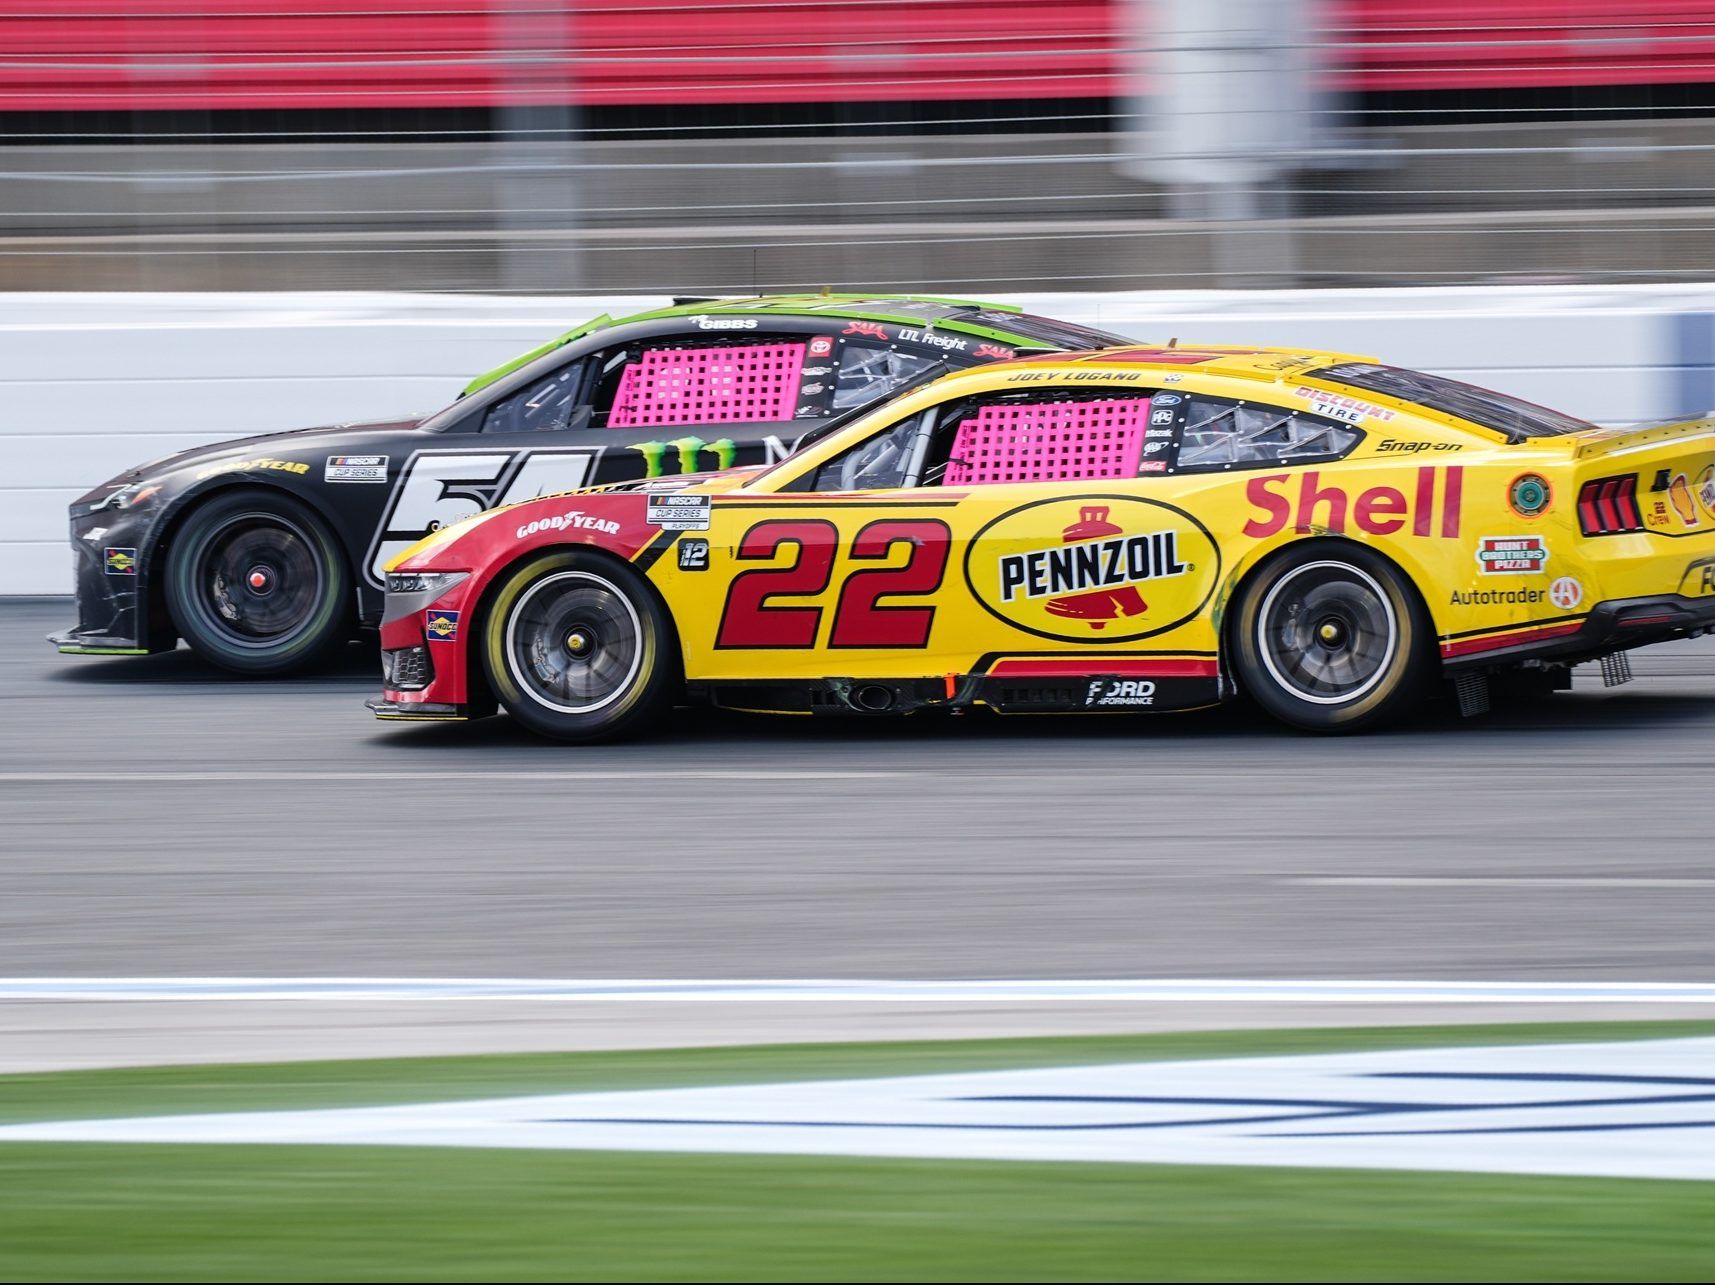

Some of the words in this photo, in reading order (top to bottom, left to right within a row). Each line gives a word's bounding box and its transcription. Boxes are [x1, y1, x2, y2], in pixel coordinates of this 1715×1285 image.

[699, 319, 758, 329] GIBBS
[898, 328, 919, 341] LTL
[922, 332, 968, 350] Freight
[1007, 372, 1057, 382] JOEY
[1061, 372, 1141, 382] LOGANO
[1295, 387, 1395, 421] DISCOUNT
[1317, 404, 1361, 421] TIRE
[1375, 439, 1463, 453] Snap-on
[344, 457, 380, 465] NASCAR
[667, 497, 702, 505] NASCAR
[1241, 466, 1464, 538] Shell
[516, 511, 620, 538] GOODYEAR
[1494, 541, 1529, 550] HUNT
[683, 543, 708, 566] 12
[1482, 550, 1544, 560] BROTHERS
[1002, 531, 1185, 601] PENNZOIL
[1494, 560, 1531, 569] PIZZA
[713, 518, 952, 650] 22
[1701, 566, 1715, 594] F
[1450, 587, 1545, 605] Autotrader
[1086, 697, 1154, 705] PFORMANCE
